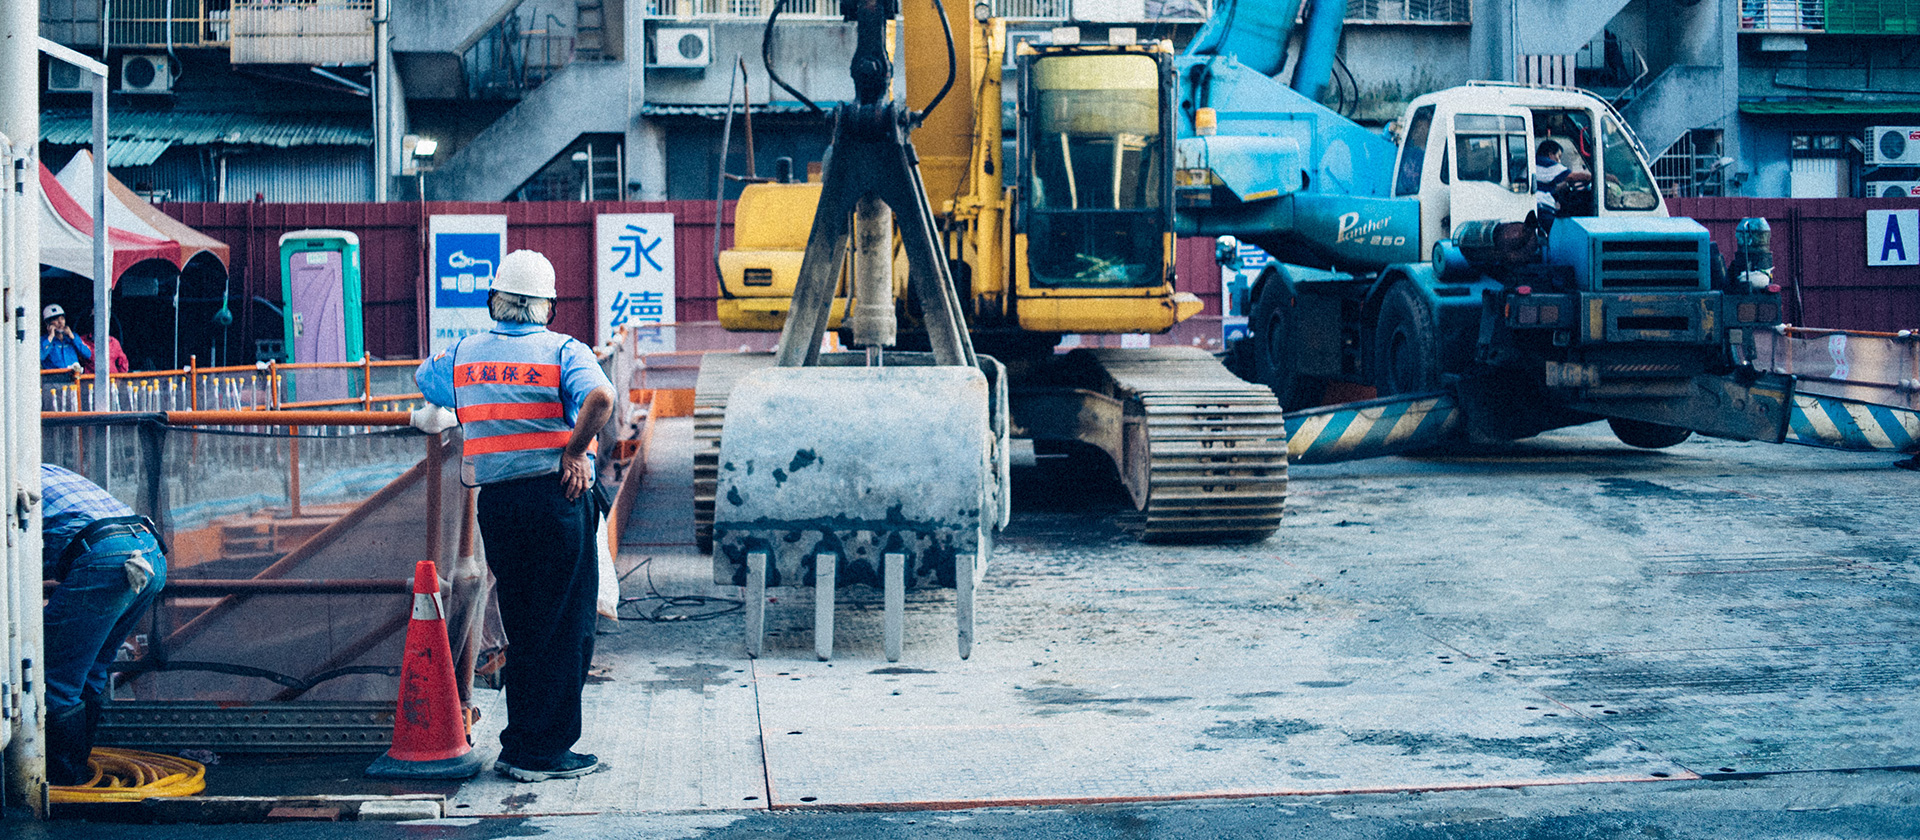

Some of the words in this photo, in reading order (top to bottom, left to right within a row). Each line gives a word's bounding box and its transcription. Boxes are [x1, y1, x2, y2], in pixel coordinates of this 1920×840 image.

[1336, 211, 1392, 244] Panther
[1370, 235, 1406, 246] 250
[1880, 214, 1907, 261] A
